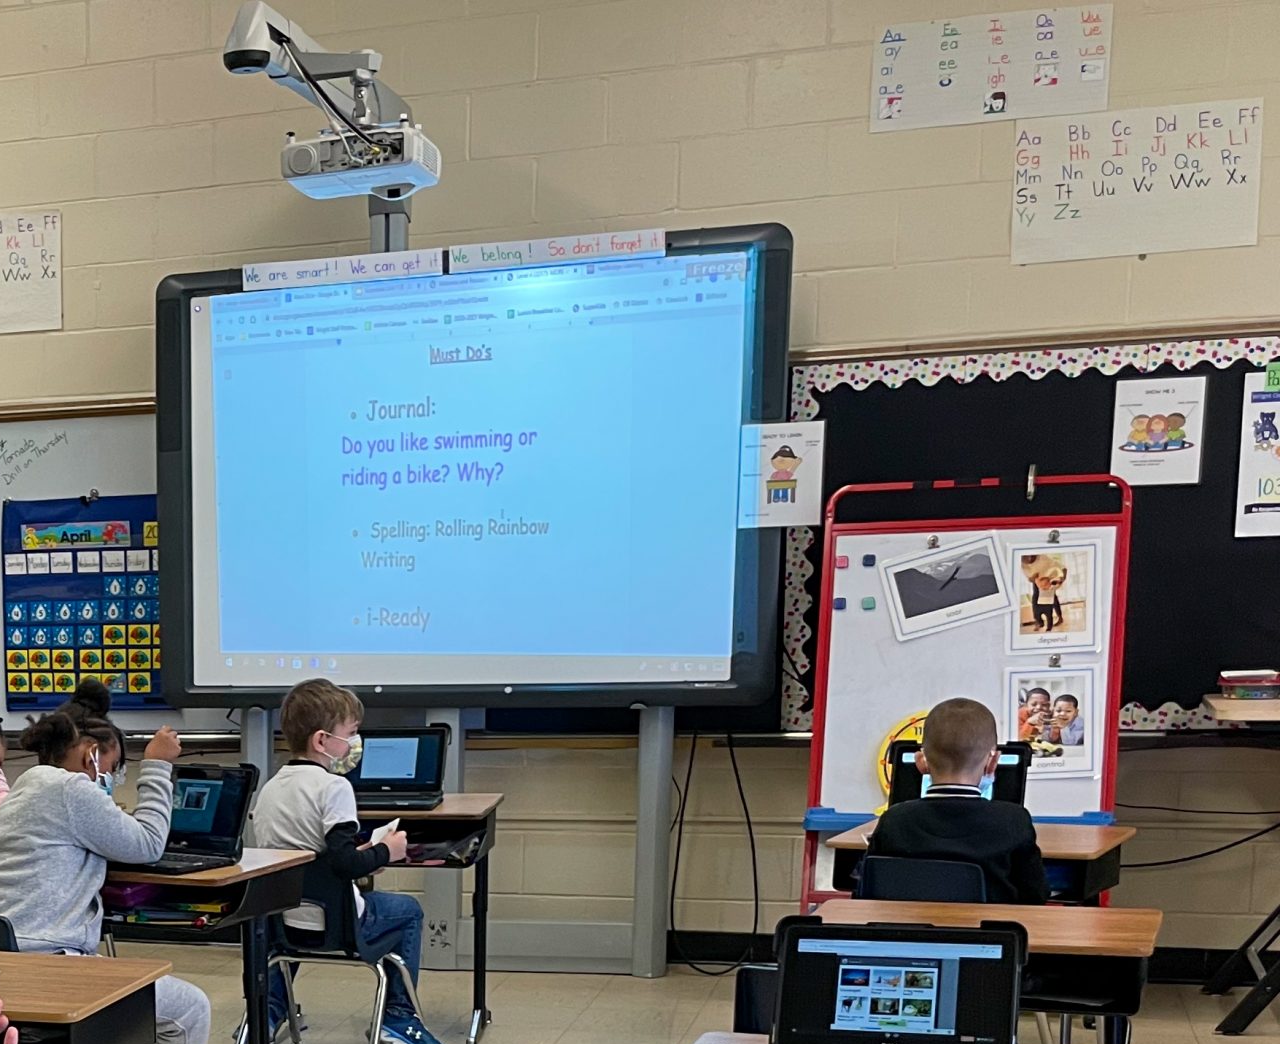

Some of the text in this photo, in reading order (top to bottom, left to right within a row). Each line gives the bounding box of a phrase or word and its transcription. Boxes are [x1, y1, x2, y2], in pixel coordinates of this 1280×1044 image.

[885, 45, 901, 60] ay
[940, 40, 958, 51] ea
[881, 64, 893, 76] ai
[938, 59, 957, 70] ee
[1016, 107, 1259, 147] Aa Bb Cc Dd Ee Ff
[1016, 128, 1248, 168] Gg Hh Ii Jj Kk Ll
[1016, 149, 1241, 185] Mm Nn Oo Pp Qq Rr
[1016, 168, 1247, 205] Ss Tt Uu Vv Ww Xx
[18, 218, 34, 232] Ee
[44, 216, 57, 230] Ff
[1016, 203, 1082, 227] Yy Zz
[7, 236, 21, 249] Kk
[32, 234, 44, 248] Ll
[452, 249, 469, 264] We
[548, 241, 565, 256] So
[610, 234, 642, 253] forget
[9, 252, 28, 268] Qq
[41, 249, 55, 262] Rr
[245, 270, 261, 283] We
[269, 272, 287, 280] are
[350, 259, 367, 274] We
[375, 263, 395, 272] can
[403, 254, 420, 276] get
[430, 253, 437, 268] it
[693, 262, 743, 276] Freeze
[2, 268, 31, 282] Ww
[42, 265, 56, 279] Xx
[431, 345, 492, 363] Must Do's
[367, 396, 436, 421] Journal:
[342, 429, 537, 458] Do you like swimming or
[1, 465, 22, 485] Drill
[31, 431, 68, 458] Thursday
[342, 462, 503, 490] riding a bike? Why?
[60, 530, 91, 545] April
[371, 518, 549, 543] Spelling: Rolling Rainbow
[361, 551, 415, 571] Writing
[367, 607, 430, 632] i-Ready
[1036, 760, 1065, 768] control
